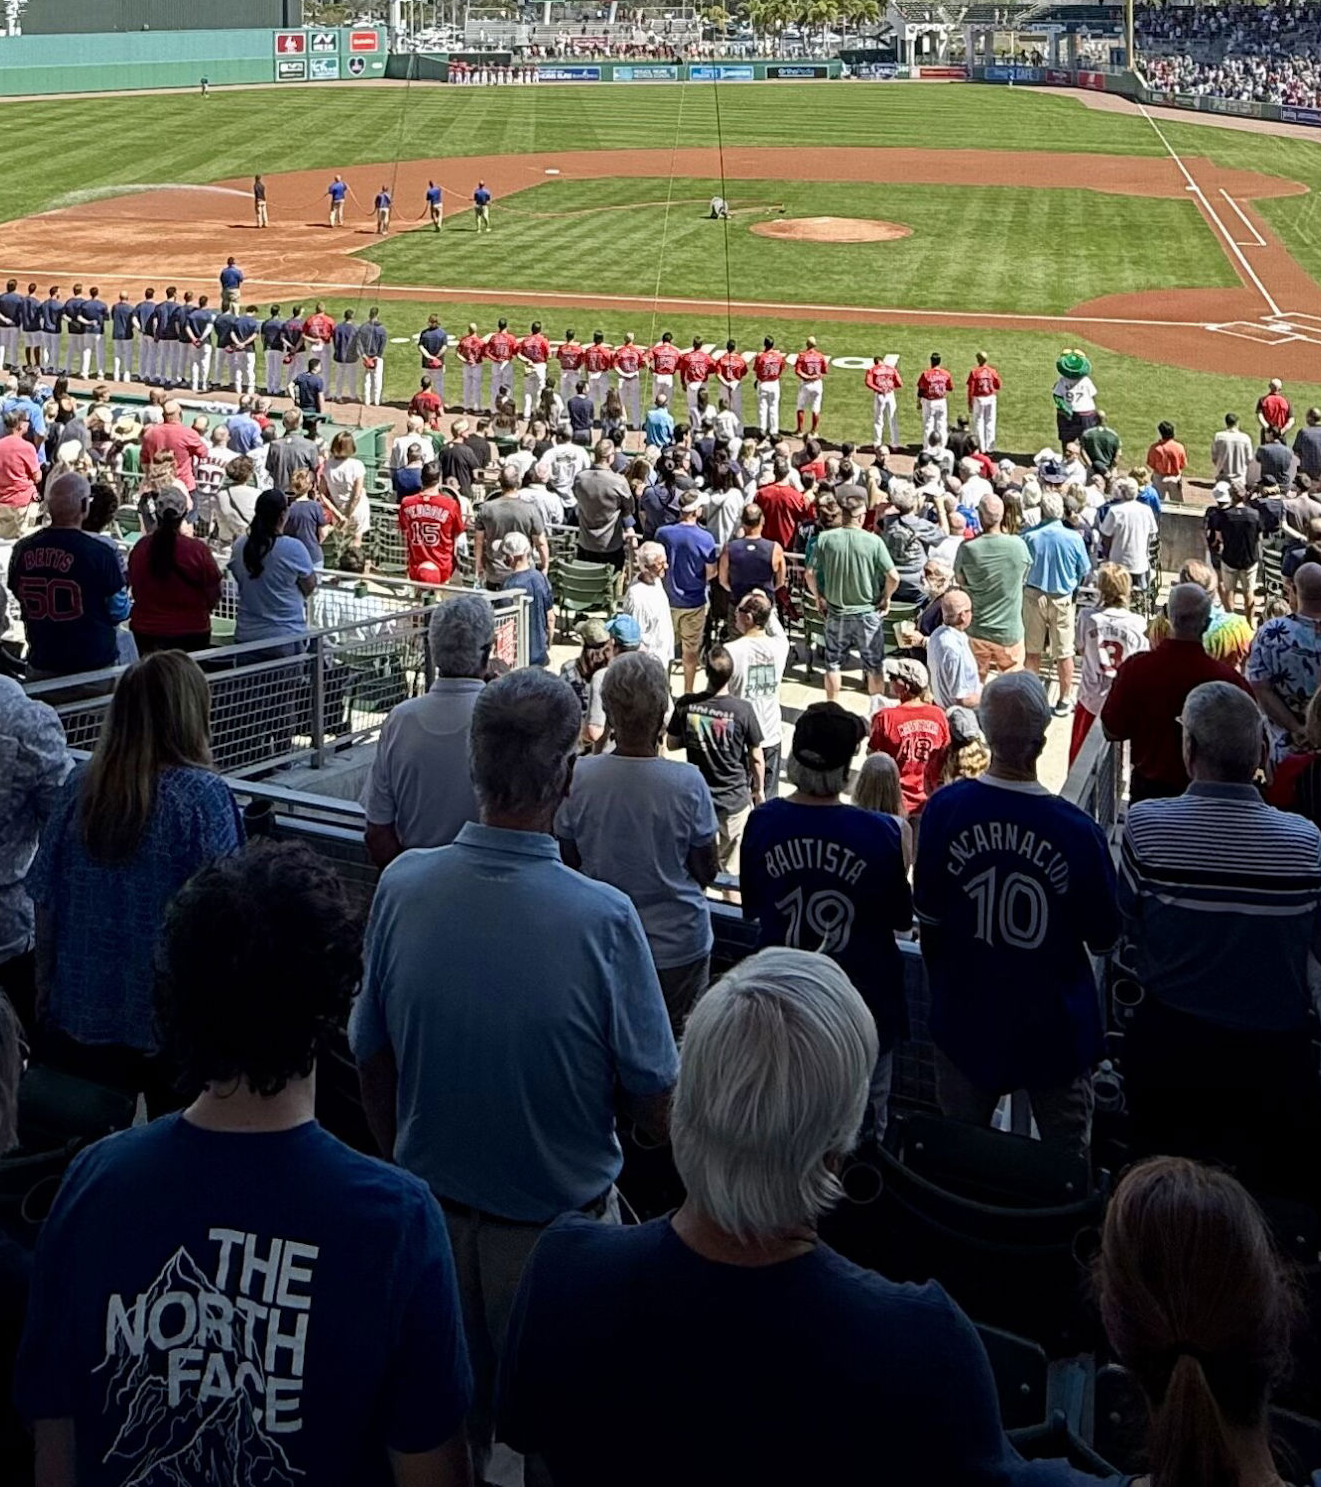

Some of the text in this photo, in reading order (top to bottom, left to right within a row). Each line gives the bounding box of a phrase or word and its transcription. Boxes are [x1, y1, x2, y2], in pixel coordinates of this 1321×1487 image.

[1064, 391, 1085, 403] 97
[24, 547, 74, 573] BETTS
[410, 521, 441, 547] 15
[18, 576, 84, 622] 50
[765, 838, 867, 886] BAUTISTA
[774, 885, 856, 953] 19
[962, 866, 1048, 950] 10
[208, 1227, 320, 1310] THE
[105, 1291, 310, 1377] NORTH
[167, 1347, 303, 1434] FACE
